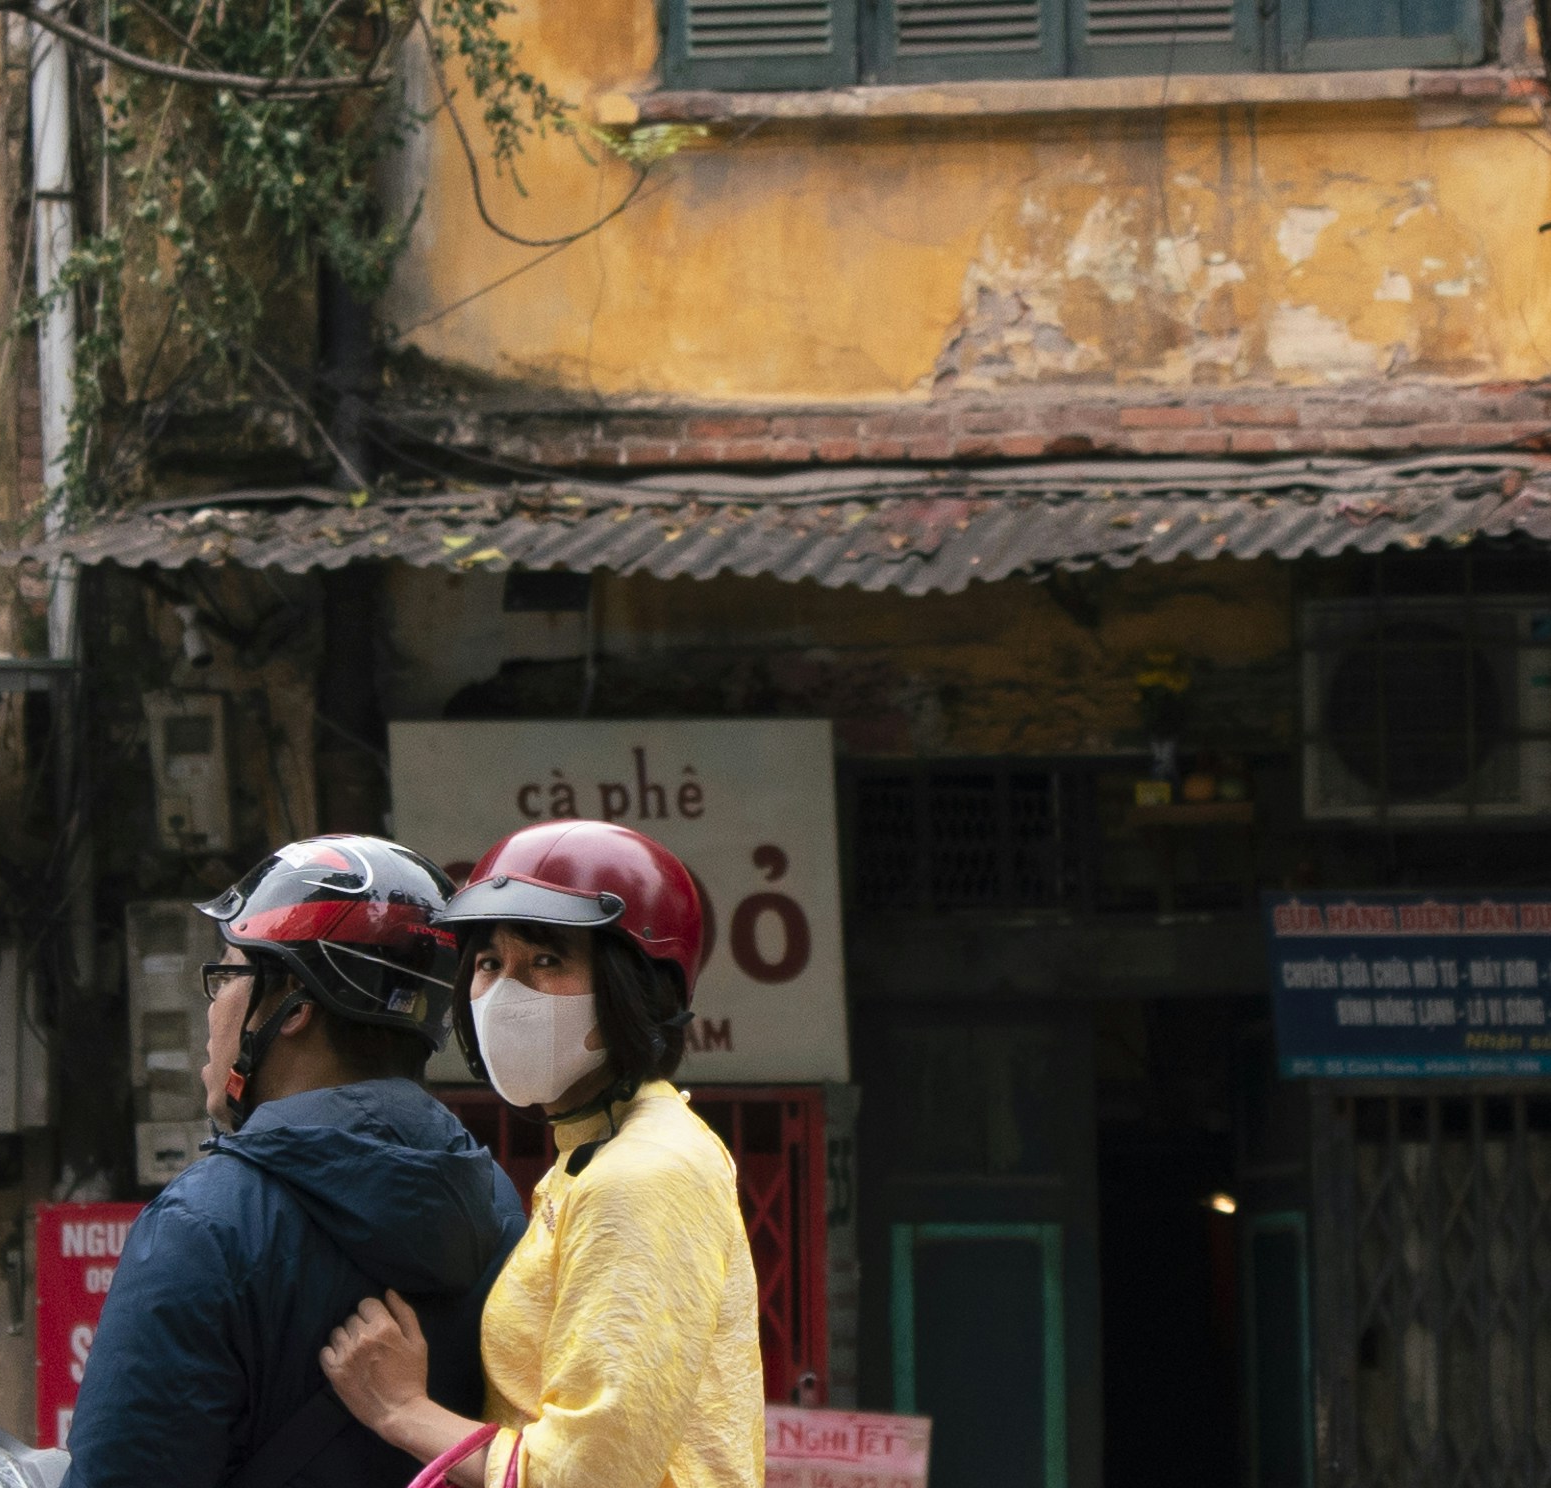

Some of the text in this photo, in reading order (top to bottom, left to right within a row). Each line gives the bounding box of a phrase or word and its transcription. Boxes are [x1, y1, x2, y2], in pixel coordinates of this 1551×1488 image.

[516, 746, 705, 822] cà phê
[62, 1222, 135, 1258] NGU
[70, 1325, 96, 1384] S
